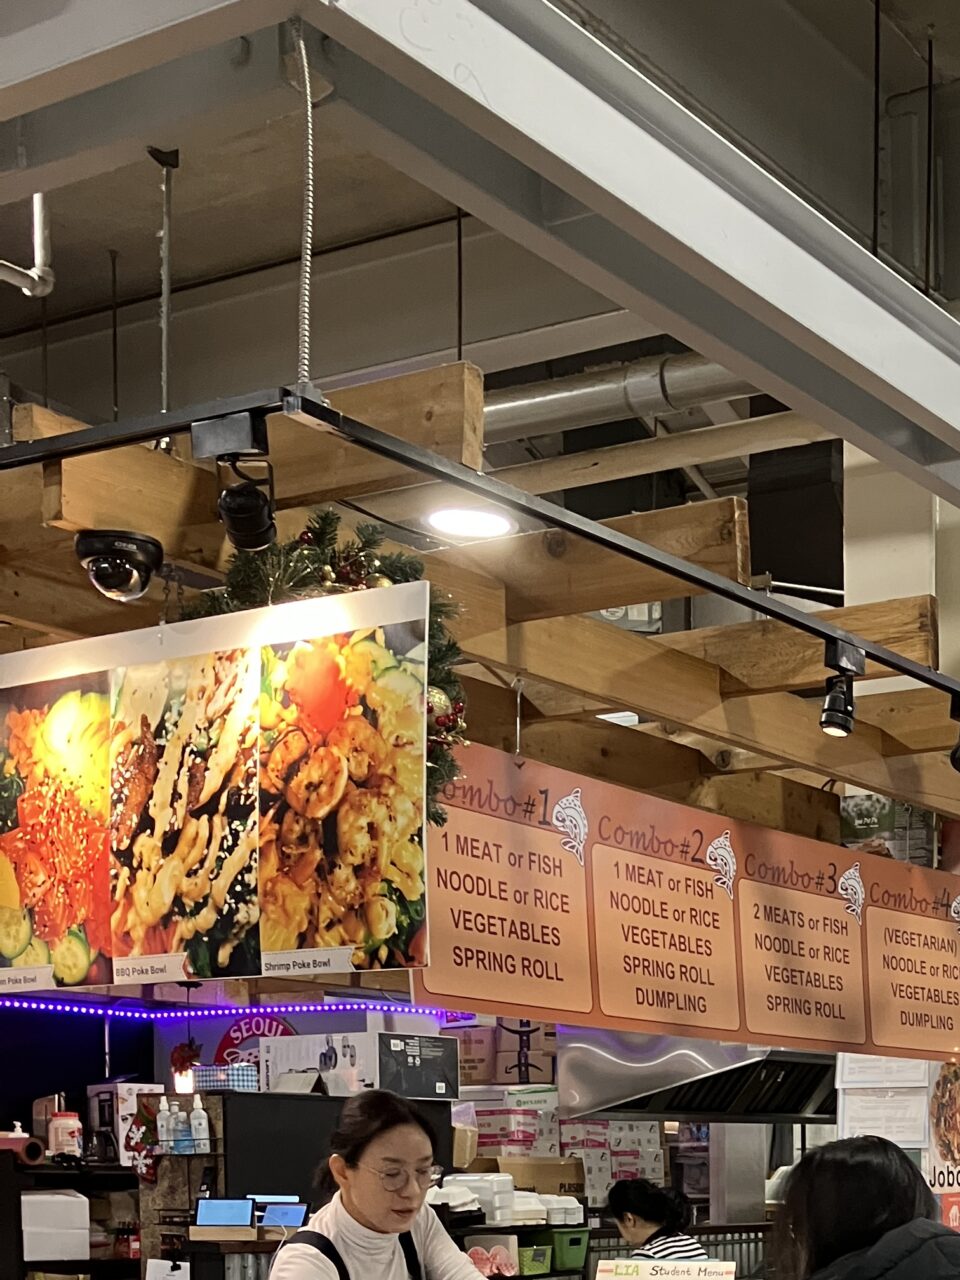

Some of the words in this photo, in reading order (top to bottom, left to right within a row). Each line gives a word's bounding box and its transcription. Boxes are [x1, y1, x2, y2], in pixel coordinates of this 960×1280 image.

[441, 779, 550, 825] ombo#1
[441, 832, 449, 851] 1
[456, 834, 502, 863] MEAT
[508, 852, 523, 869] or
[529, 852, 563, 877] FISH
[436, 868, 508, 901] NOODLE
[514, 889, 529, 905] or
[534, 888, 570, 913] RICE
[614, 861, 620, 878] 1
[625, 863, 663, 888] MEAT
[668, 878, 681, 892] or
[685, 877, 714, 899] FISH
[610, 891, 668, 919] NOODLE
[673, 909, 686, 923] or
[689, 908, 720, 929] RICE
[754, 903, 760, 919] 2
[764, 905, 805, 928] MEATS
[809, 918, 820, 931] or
[823, 917, 849, 936] FISH
[450, 907, 561, 946] VEGETABLES
[621, 924, 712, 957] VEGETABLES
[884, 927, 958, 957] (VEGETARIAN)
[453, 946, 516, 974] SPRING
[522, 957, 564, 981] ROLL
[754, 933, 805, 957] NOODLE
[809, 947, 820, 959] or
[824, 946, 850, 964] RICE
[116, 967, 130, 976] BBQ
[132, 966, 149, 976] Poke
[151, 965, 167, 975] Bowl
[264, 962, 291, 972] Shrimp
[293, 961, 311, 969] Poke
[312, 958, 331, 968] Bowl
[623, 955, 675, 980] SPRING
[680, 964, 715, 986] ROLL
[765, 965, 843, 991] VEGETABLES
[882, 954, 926, 975] NOODLE
[930, 966, 939, 977] or
[636, 987, 707, 1013] DUMPLING
[767, 995, 811, 1016] SPRING
[815, 1001, 846, 1019] ROLL
[891, 982, 960, 1006] VEGETABLES
[900, 1011, 954, 1031] DUMPLING
[650, 1265, 691, 1276] Student
[698, 1267, 724, 1277] Menu
